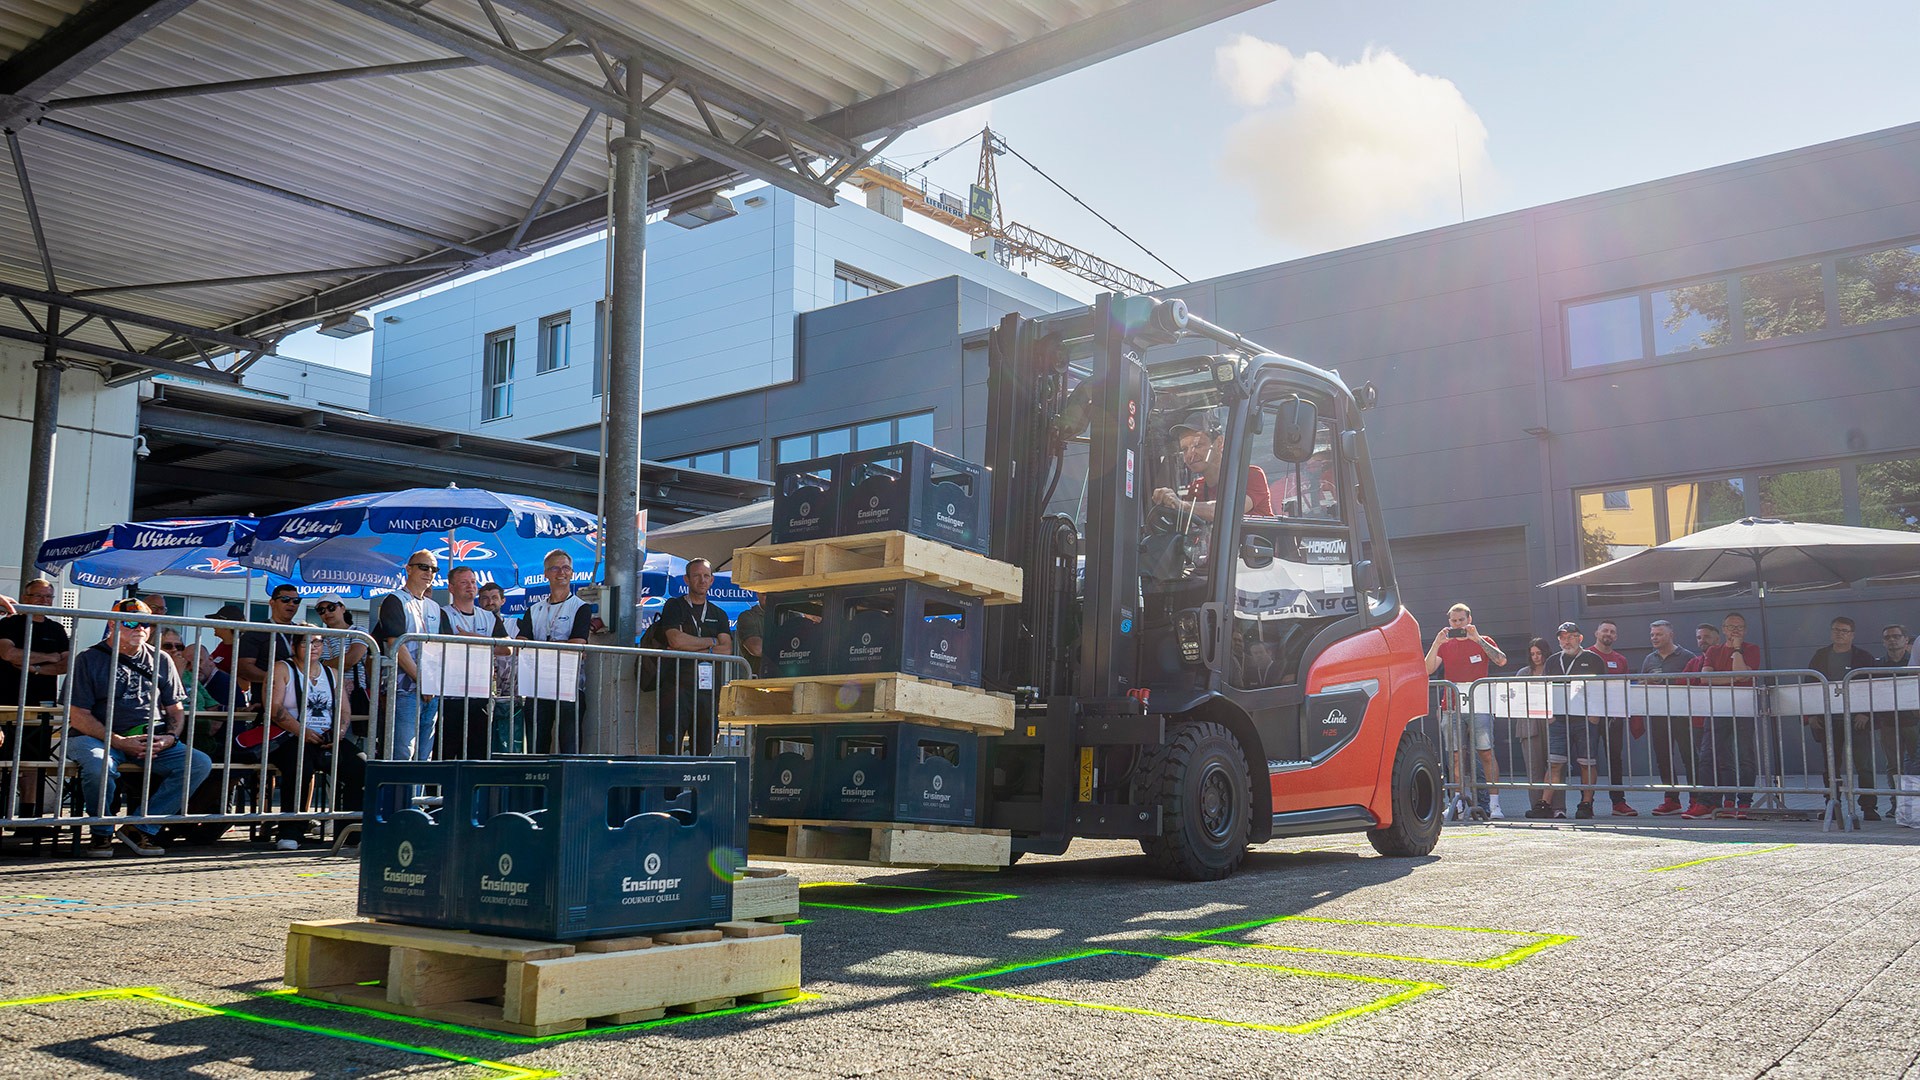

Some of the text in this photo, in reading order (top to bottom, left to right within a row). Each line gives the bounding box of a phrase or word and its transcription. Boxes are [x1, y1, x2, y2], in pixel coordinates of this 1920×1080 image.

[926, 197, 964, 219] LIEBHERR
[857, 507, 890, 519] Ensinger
[936, 512, 965, 528] Ensinger
[279, 517, 343, 535] Wüteria
[388, 516, 498, 531] MINERALQUELLEN
[790, 518, 820, 527] Ensinger
[132, 531, 203, 548] Wüteria
[1308, 540, 1347, 554] HOFMANN
[780, 650, 811, 659] Ensinger
[849, 646, 883, 656] Ensinger
[930, 649, 958, 663] Ensinger
[1322, 708, 1348, 724] Linde
[770, 785, 802, 797] Ensinger
[841, 787, 876, 798] Ensinger
[923, 790, 951, 803] Ensinger
[384, 867, 427, 886] Ensinger
[481, 875, 530, 895] Ensinger
[622, 877, 681, 892] Ensinger
[481, 896, 529, 906] GOURMET QUELLE
[622, 893, 680, 905] GOURMET QUELLE
